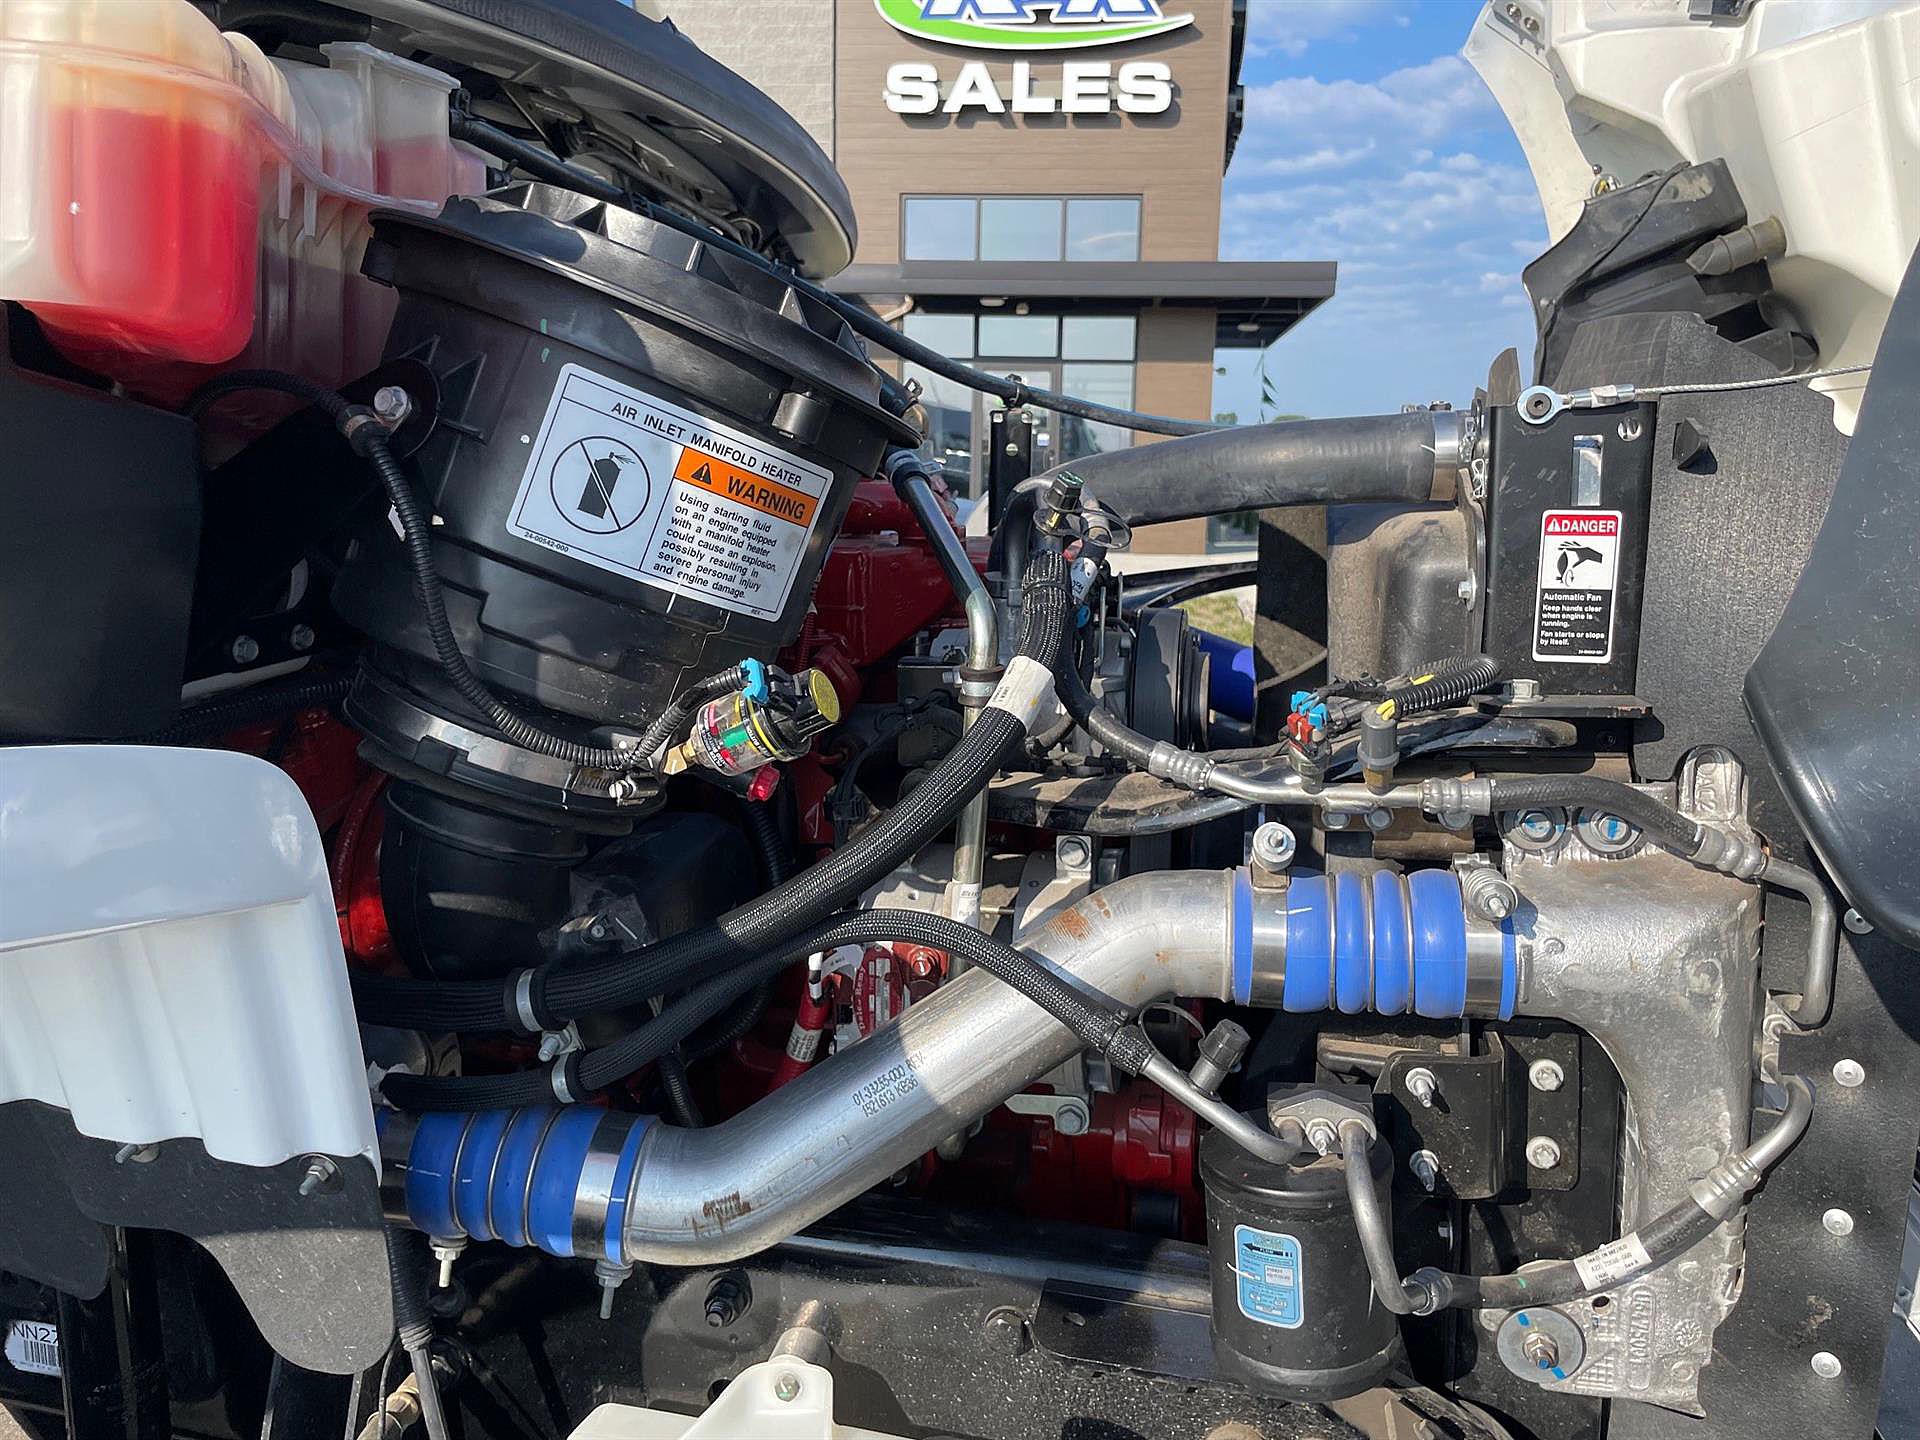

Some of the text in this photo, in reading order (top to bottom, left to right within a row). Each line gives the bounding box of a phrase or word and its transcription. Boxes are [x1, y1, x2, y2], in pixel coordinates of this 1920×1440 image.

[885, 62, 1173, 114] SALES
[611, 402, 802, 487] AIR INLET MANIFOLD HEATER
[680, 492, 772, 533] Using starting fluid
[727, 475, 806, 520] WARNING
[666, 528, 695, 544] could
[698, 539, 725, 555] cause
[727, 550, 739, 560] an
[671, 516, 771, 558] with a manifold heater
[675, 505, 778, 547] on an engine equipped
[1561, 519, 1617, 533] DANGER
[657, 551, 761, 593] severe personal injury
[661, 539, 759, 578] possibly resulting in
[653, 562, 746, 599] and engine damage.
[1543, 592, 1602, 602] Automatic Fan
[1541, 619, 1570, 629] running.
[1542, 604, 1602, 613] Keep hands clear
[1561, 612, 1585, 621] engine
[1586, 612, 1593, 620] is
[1539, 638, 1570, 647] by itself.
[1540, 630, 1553, 638] Fan
[1585, 631, 1605, 640] stops
